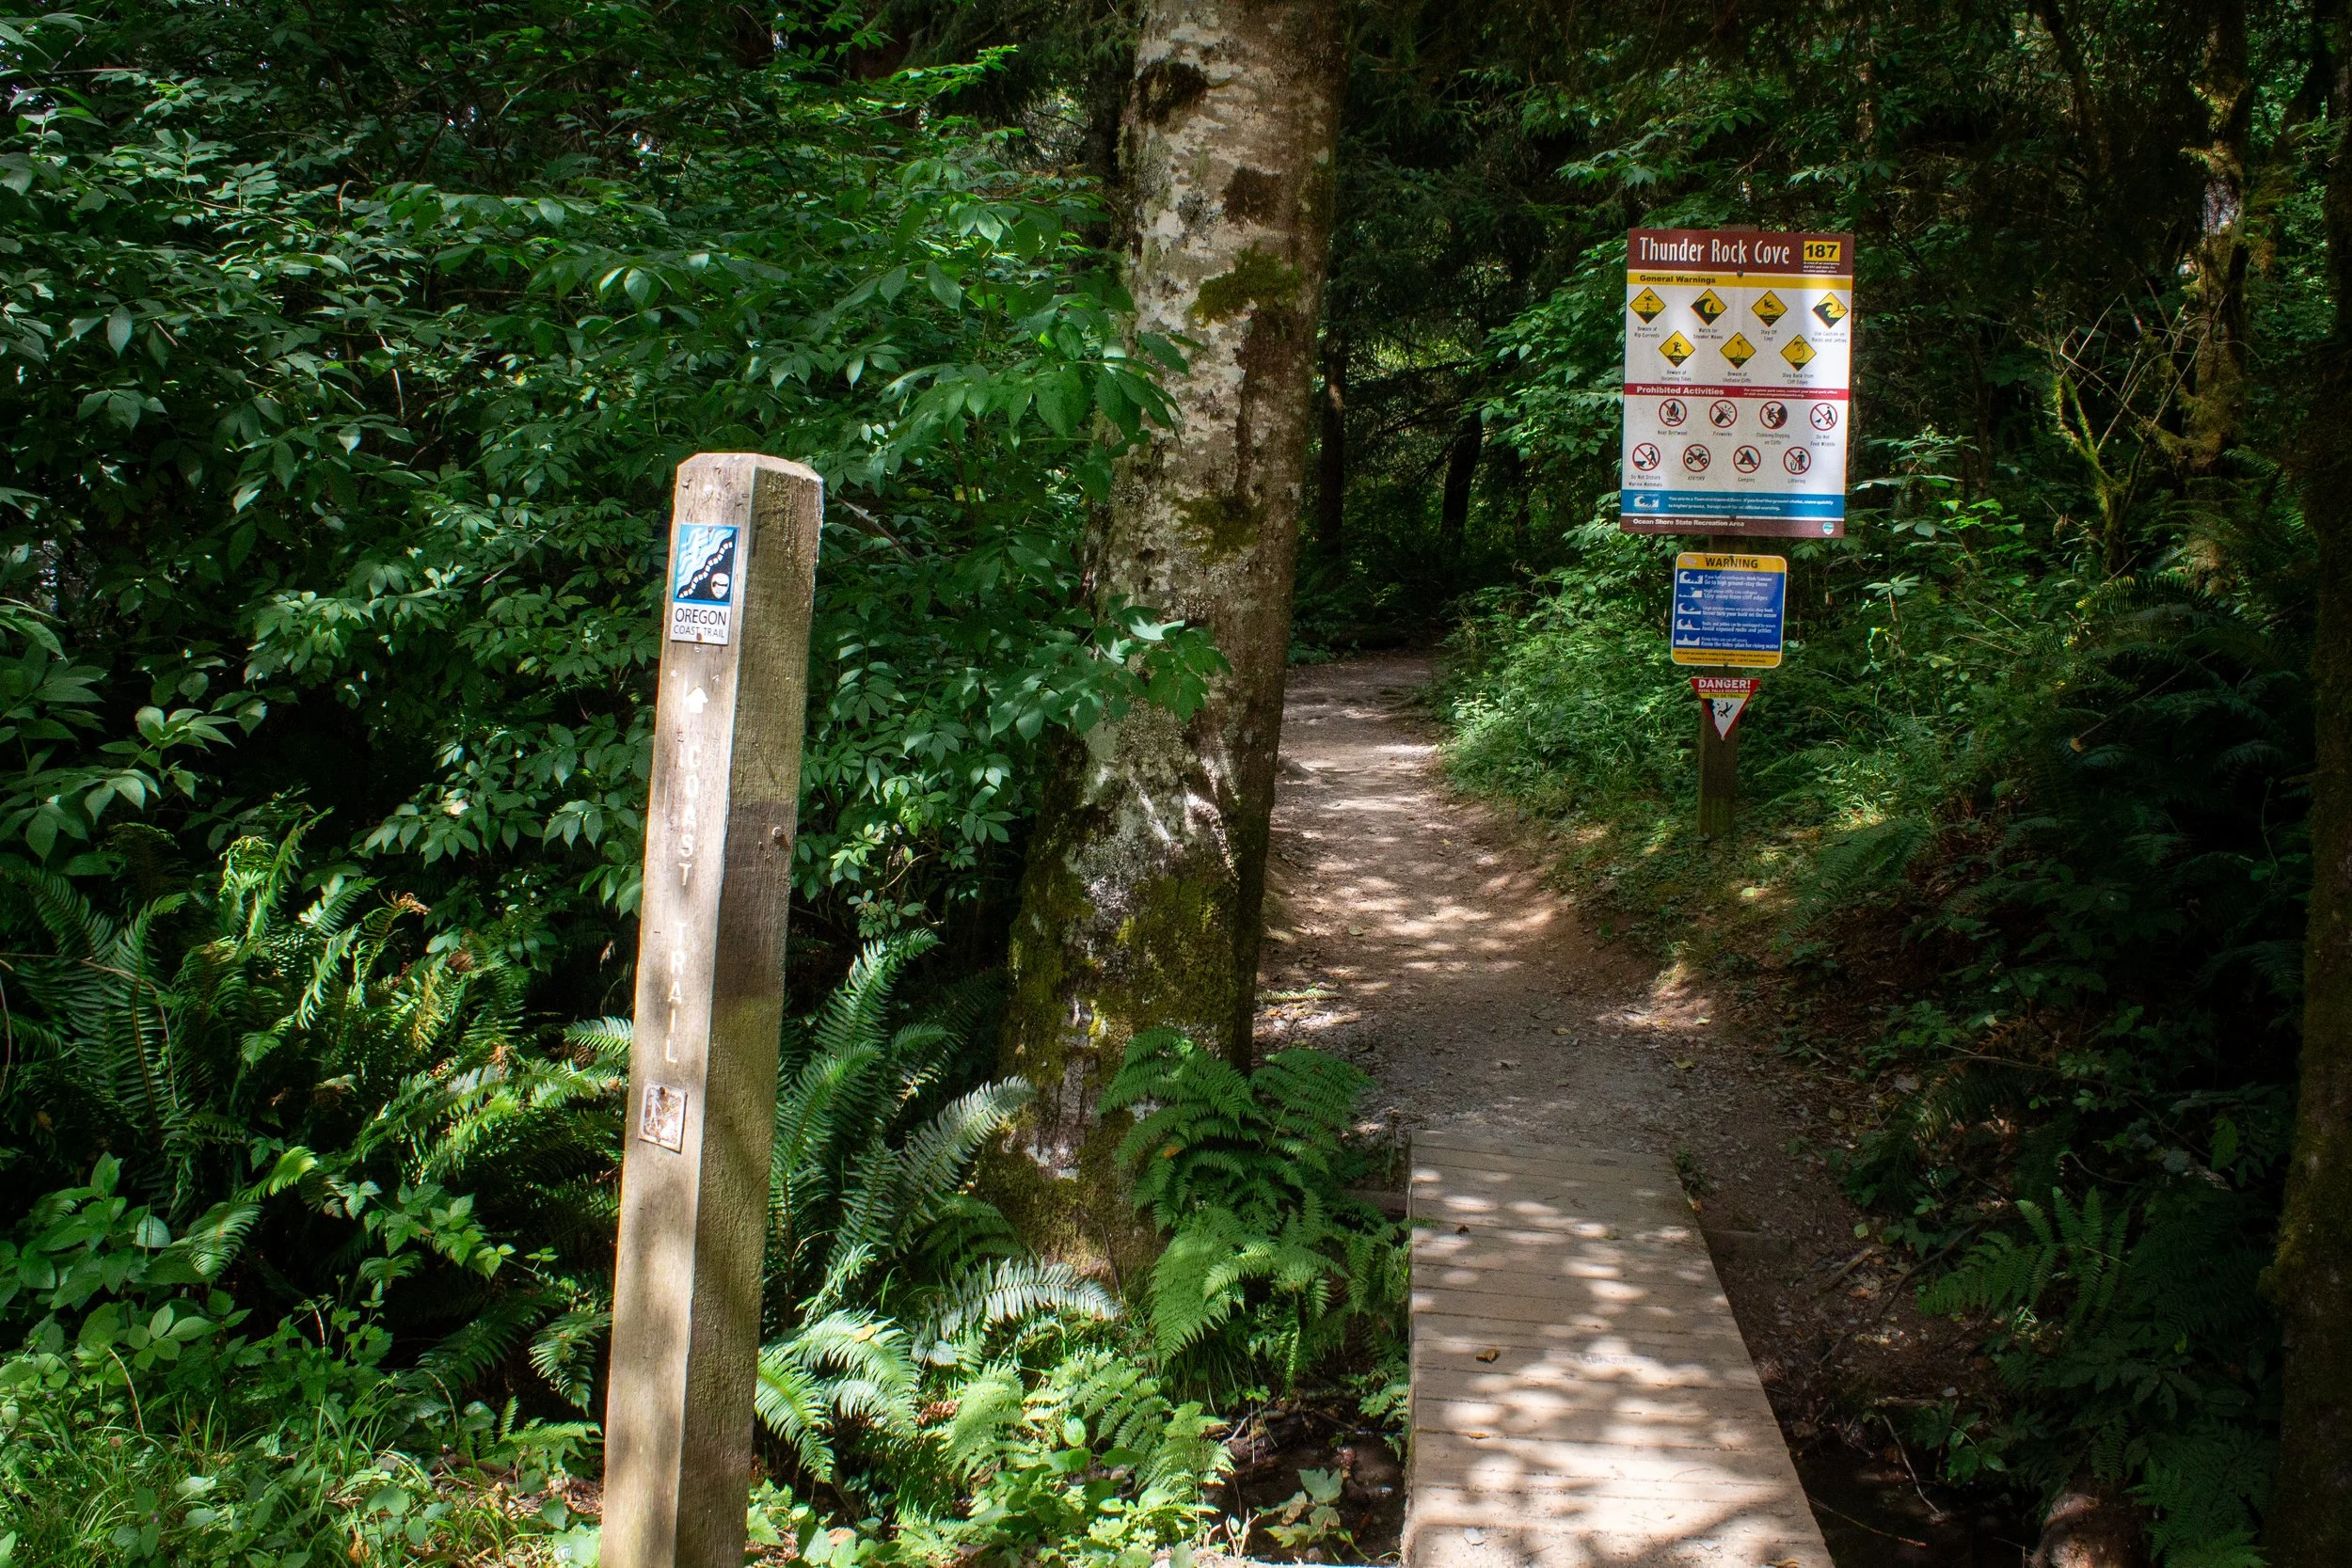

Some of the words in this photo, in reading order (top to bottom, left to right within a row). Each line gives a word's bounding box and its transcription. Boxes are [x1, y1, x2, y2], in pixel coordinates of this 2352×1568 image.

[1640, 236, 1705, 262] Thunder
[1711, 239, 1747, 264] Rock
[1754, 240, 1790, 264] Cove
[1805, 245, 1837, 258] 187
[1676, 276, 1716, 284] Warnings
[1637, 386, 1681, 394] Prohibited
[1705, 557, 1758, 568] WARNING
[675, 608, 727, 626] OREGON
[674, 625, 700, 636] COAST
[703, 627, 725, 639] TRAIL
[1698, 679, 1751, 689] DANGER!
[677, 745, 703, 887] COAST
[664, 921, 688, 1064] TRAIL
